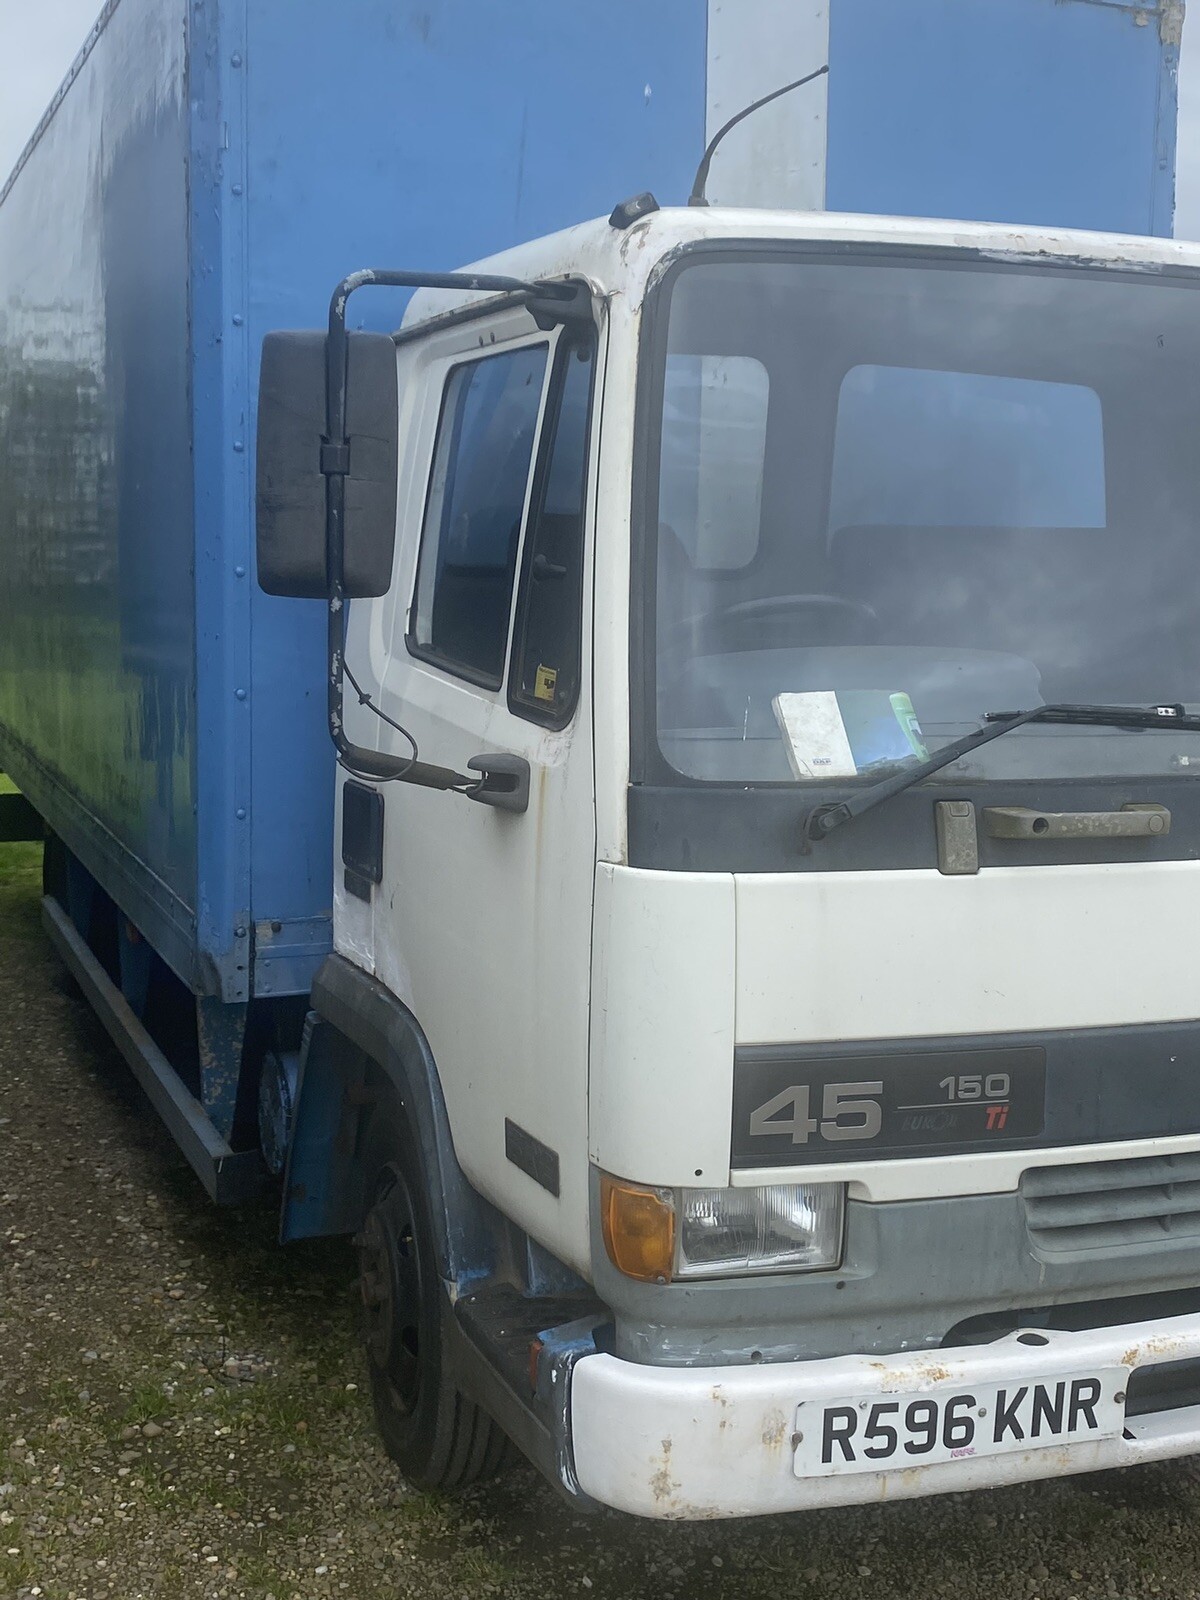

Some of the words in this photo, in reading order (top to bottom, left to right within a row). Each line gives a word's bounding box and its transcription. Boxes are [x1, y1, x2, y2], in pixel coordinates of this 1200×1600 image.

[939, 1073, 1010, 1100] 150
[750, 1081, 883, 1144] 45
[985, 1106, 1010, 1130] Ti
[821, 1394, 977, 1463] R596
[993, 1378, 1102, 1443] KNR
